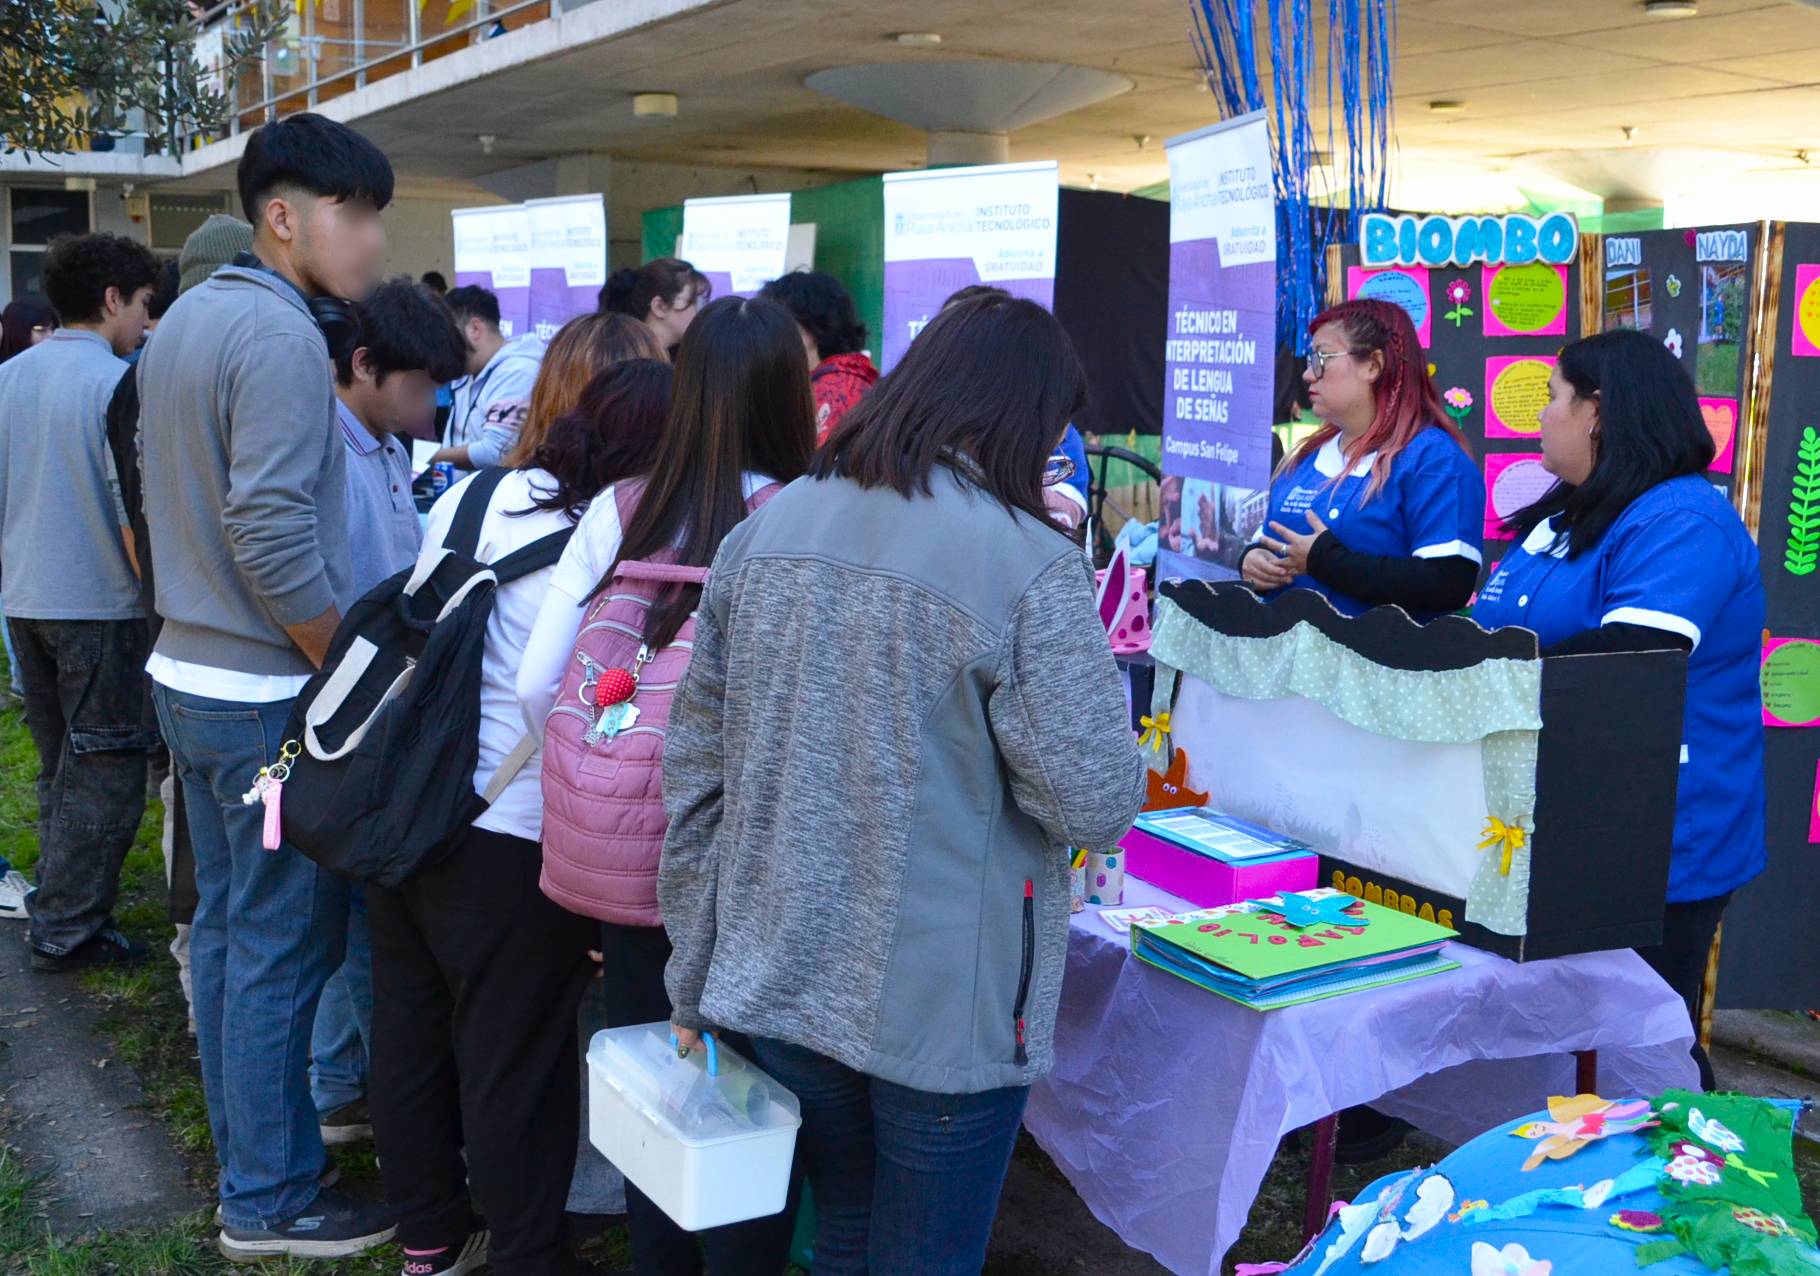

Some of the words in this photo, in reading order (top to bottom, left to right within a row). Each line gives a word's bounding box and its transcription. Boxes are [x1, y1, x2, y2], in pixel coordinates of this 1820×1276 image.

[976, 203, 1030, 217] INSTITUTO
[976, 217, 1051, 232] TECNOLÓGICO
[1363, 213, 1577, 266] BIOMBO
[1606, 238, 1641, 267] DANI
[1697, 231, 1747, 262] NAYDA
[1175, 304, 1221, 334] TÉCNICO
[1222, 310, 1238, 334] EN
[1165, 333, 1256, 365] NTERPRETACIÓN
[1173, 368, 1189, 391] DE
[1191, 369, 1233, 394] LENGUA
[1176, 397, 1193, 420] DE
[1194, 393, 1229, 424] SEÑAS
[1165, 435, 1200, 459] Campus
[1200, 440, 1216, 458] San
[1216, 443, 1239, 466] Felipe
[1332, 870, 1454, 930] SOMBRAS
